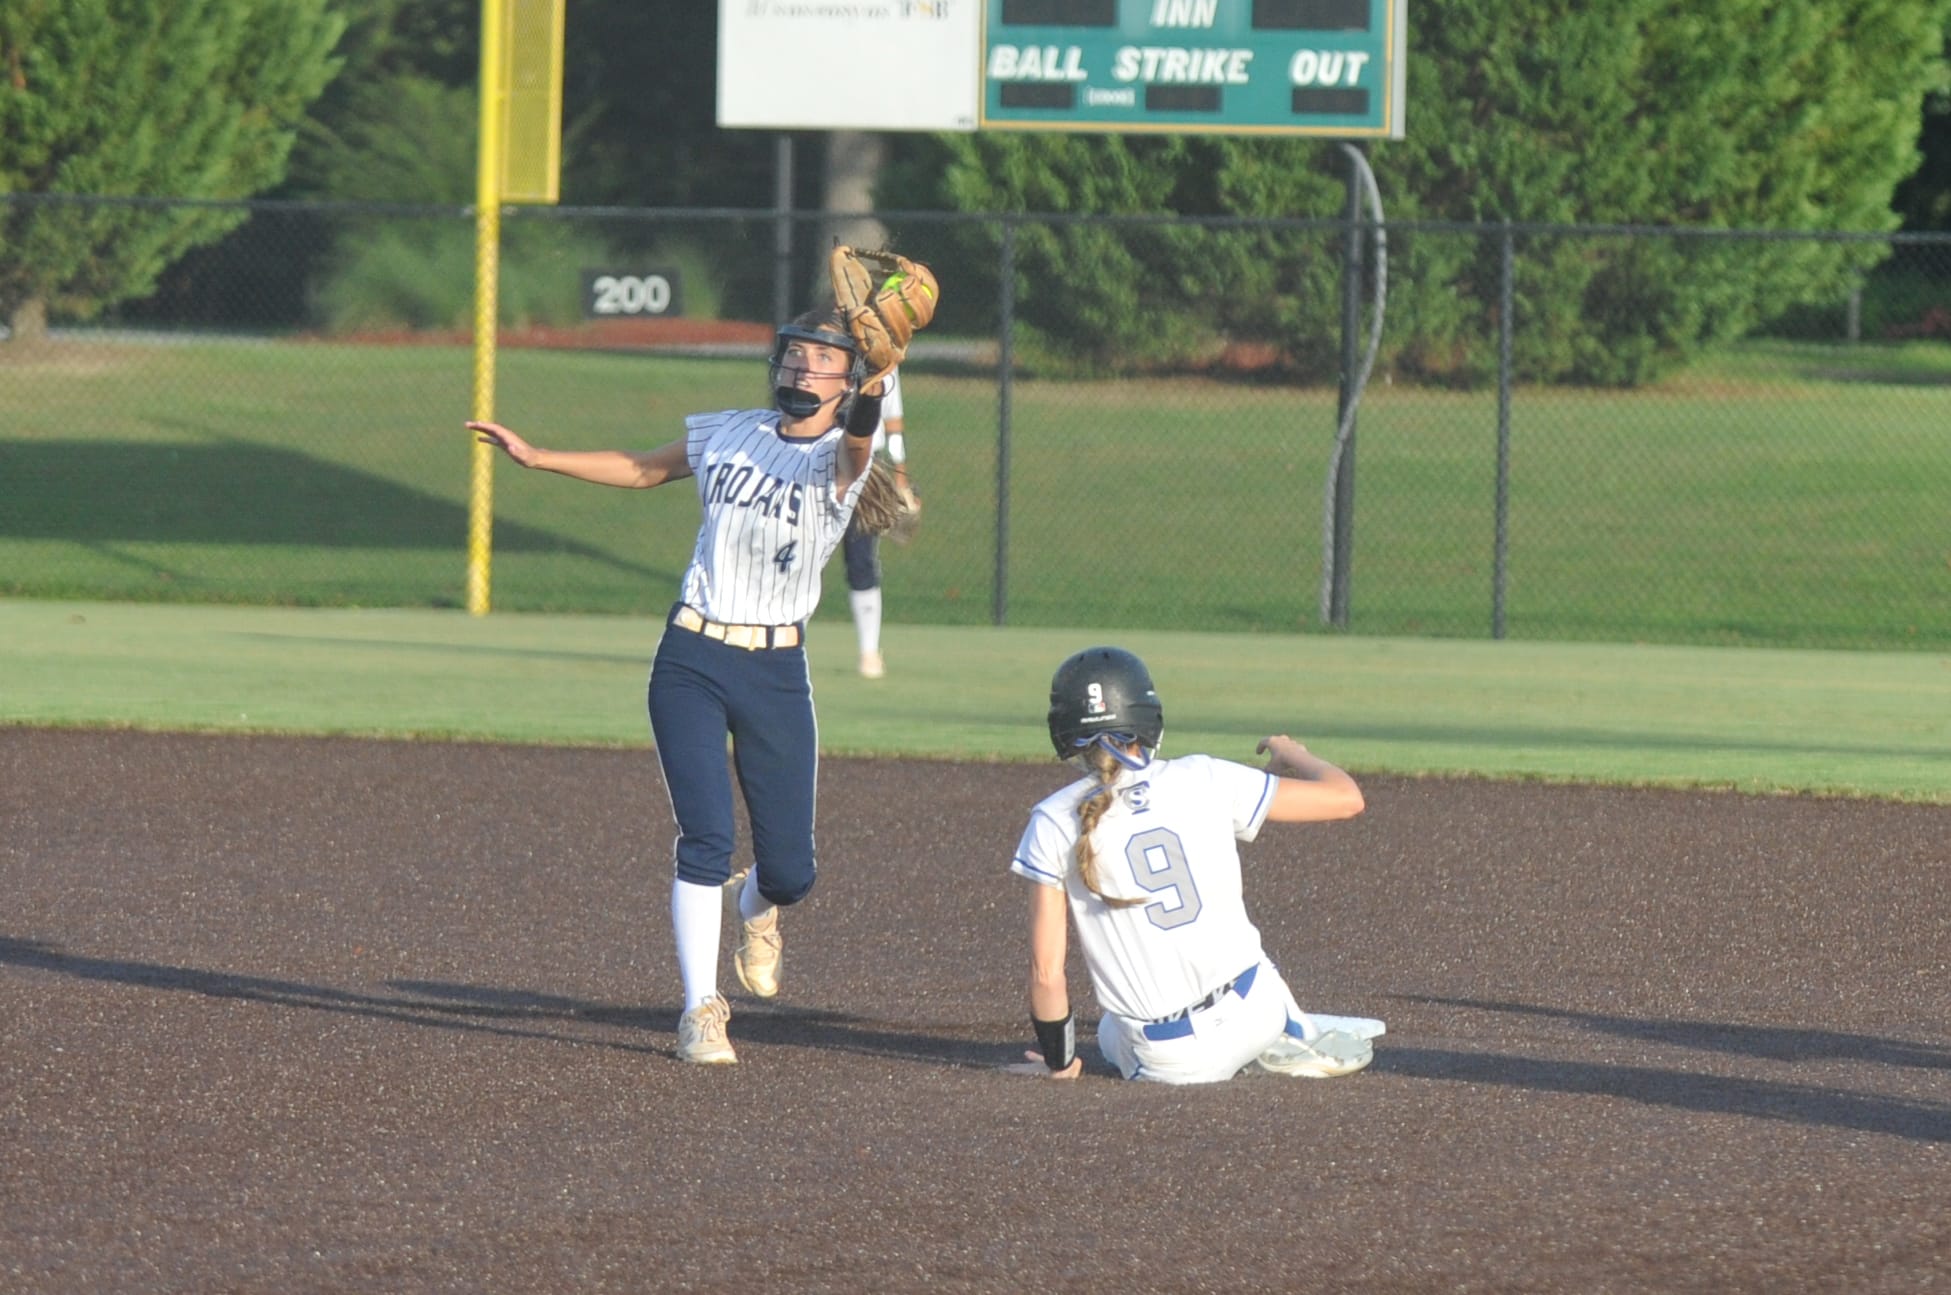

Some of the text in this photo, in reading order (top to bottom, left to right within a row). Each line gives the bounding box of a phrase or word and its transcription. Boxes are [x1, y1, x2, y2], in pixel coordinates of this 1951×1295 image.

[1152, 0, 1218, 28] INN
[989, 45, 1088, 80] BALL
[1112, 47, 1253, 82] STRIKE
[1290, 51, 1370, 85] OUT
[593, 275, 671, 314] 200
[774, 540, 797, 573] 4
[1087, 683, 1103, 704] 9
[1125, 827, 1202, 930] 9
